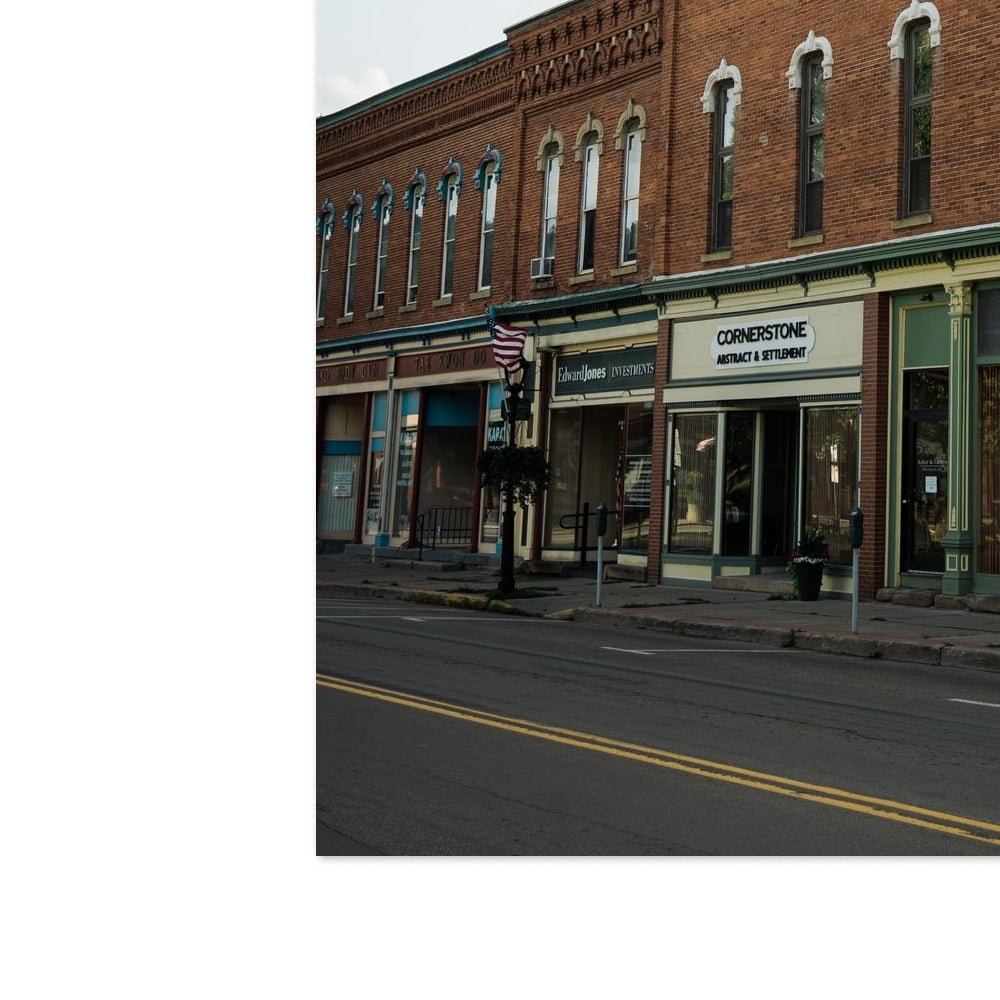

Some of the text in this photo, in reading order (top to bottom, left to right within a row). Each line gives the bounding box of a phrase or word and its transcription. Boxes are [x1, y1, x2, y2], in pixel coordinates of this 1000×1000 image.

[717, 321, 807, 346] CORNERSTONE
[716, 347, 807, 365] ABSTRACT & SETTLEMENT
[611, 362, 654, 377] INVESTMENTS
